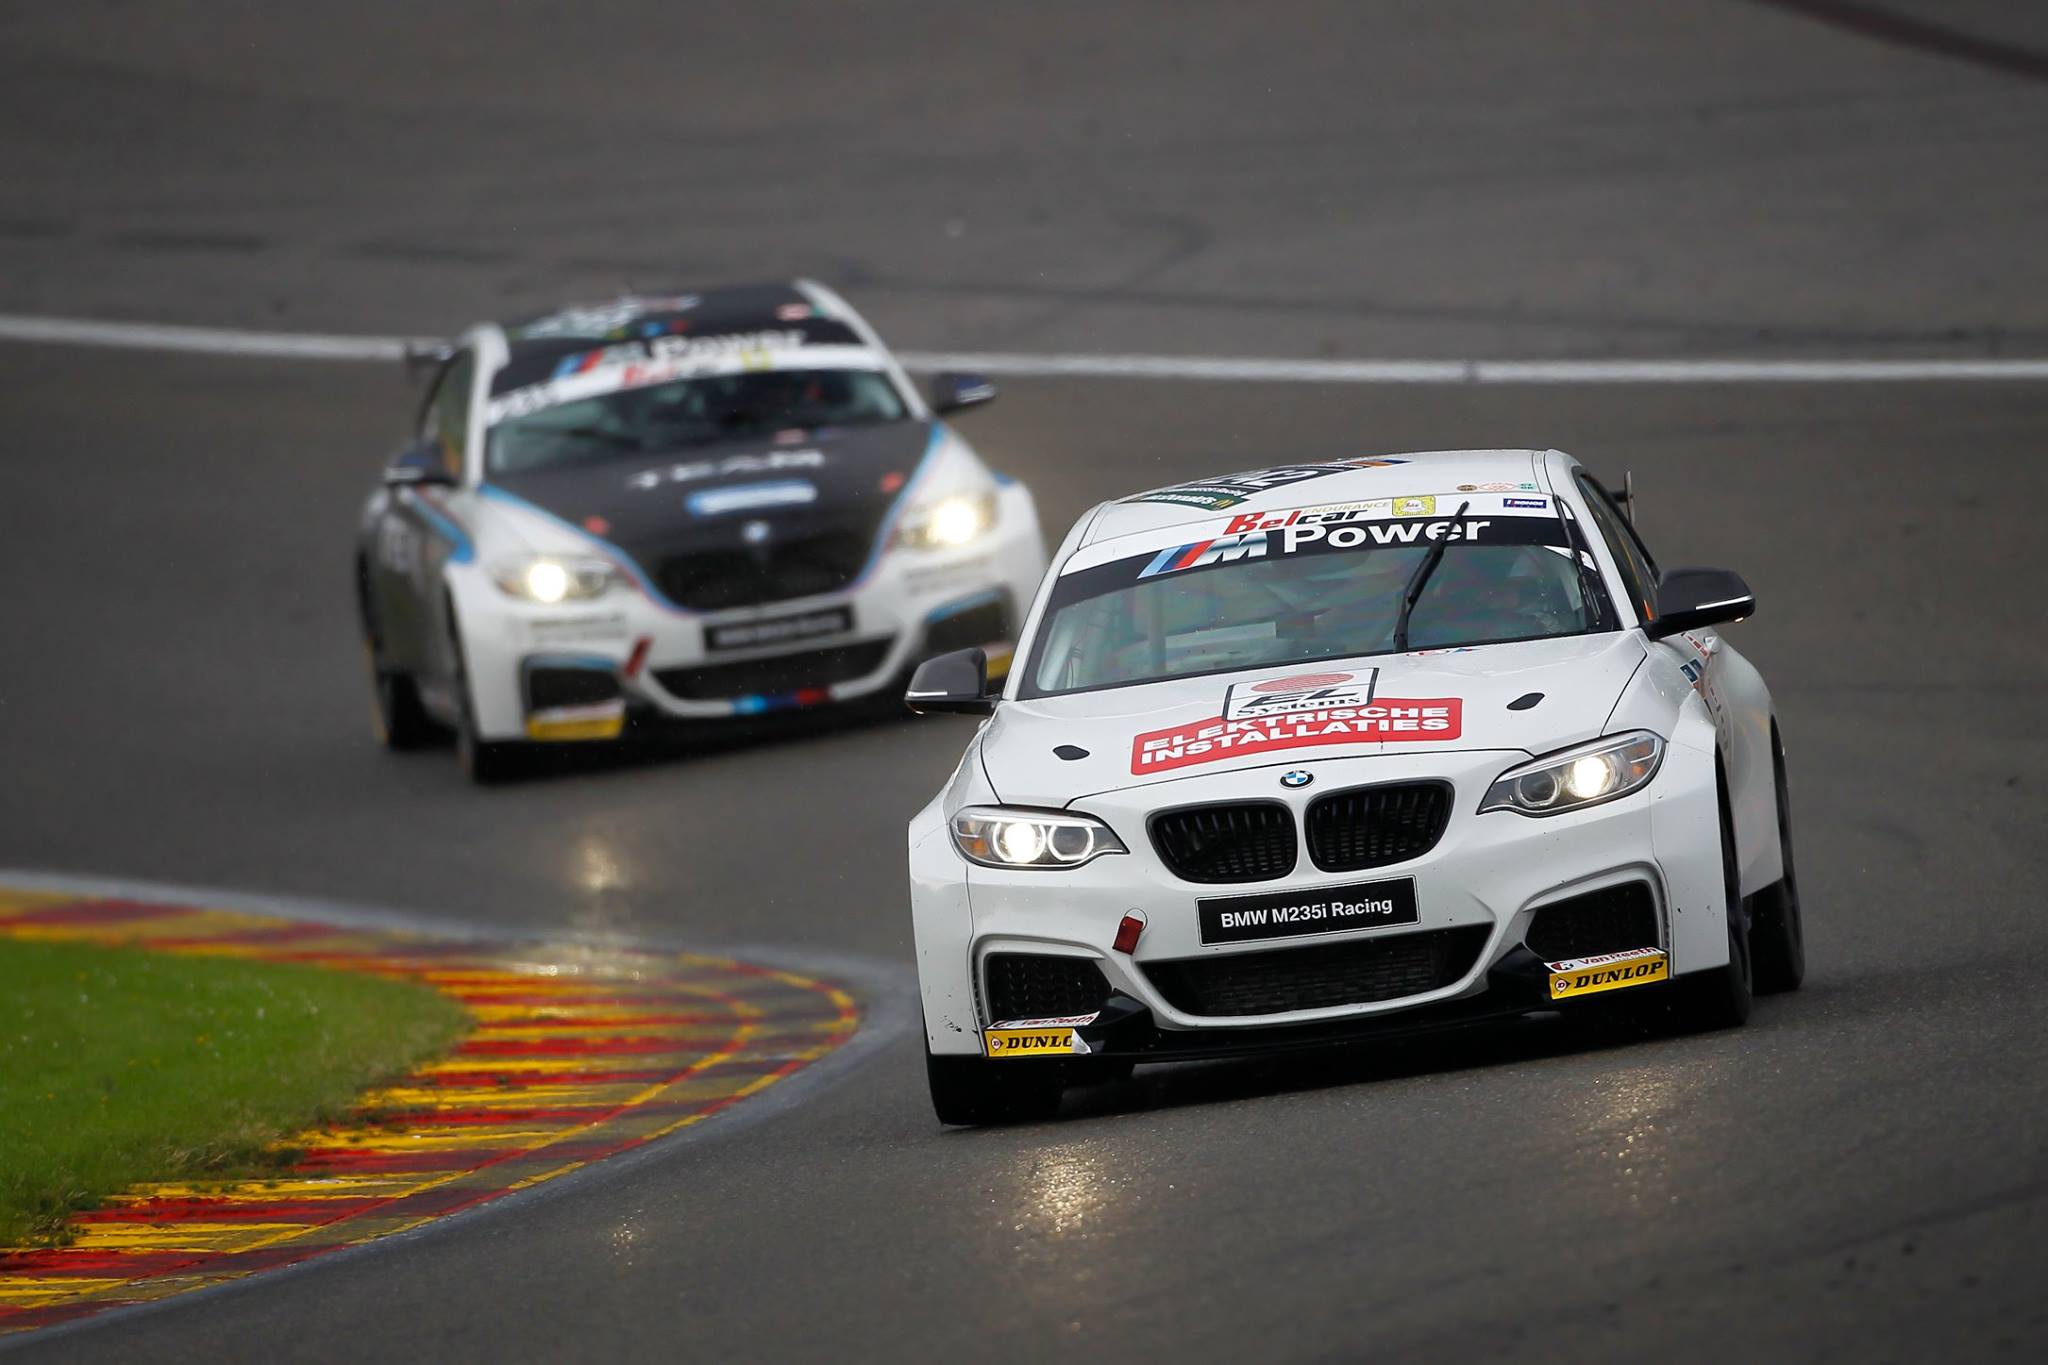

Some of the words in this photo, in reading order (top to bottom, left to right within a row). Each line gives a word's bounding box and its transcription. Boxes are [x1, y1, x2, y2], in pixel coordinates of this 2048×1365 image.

[1303, 501, 1390, 514] ENDURANCE
[1224, 510, 1368, 535] Belcar
[1284, 520, 1491, 553] Power
[1236, 698, 1360, 716] Systems
[1141, 717, 1450, 765] INSTALLATIES
[1143, 706, 1450, 751] ELEKTRISCHE
[1220, 909, 1267, 928] BMW
[1272, 903, 1327, 923] M235i
[1331, 898, 1393, 918] Racing
[1574, 961, 1664, 989] DUNLOP
